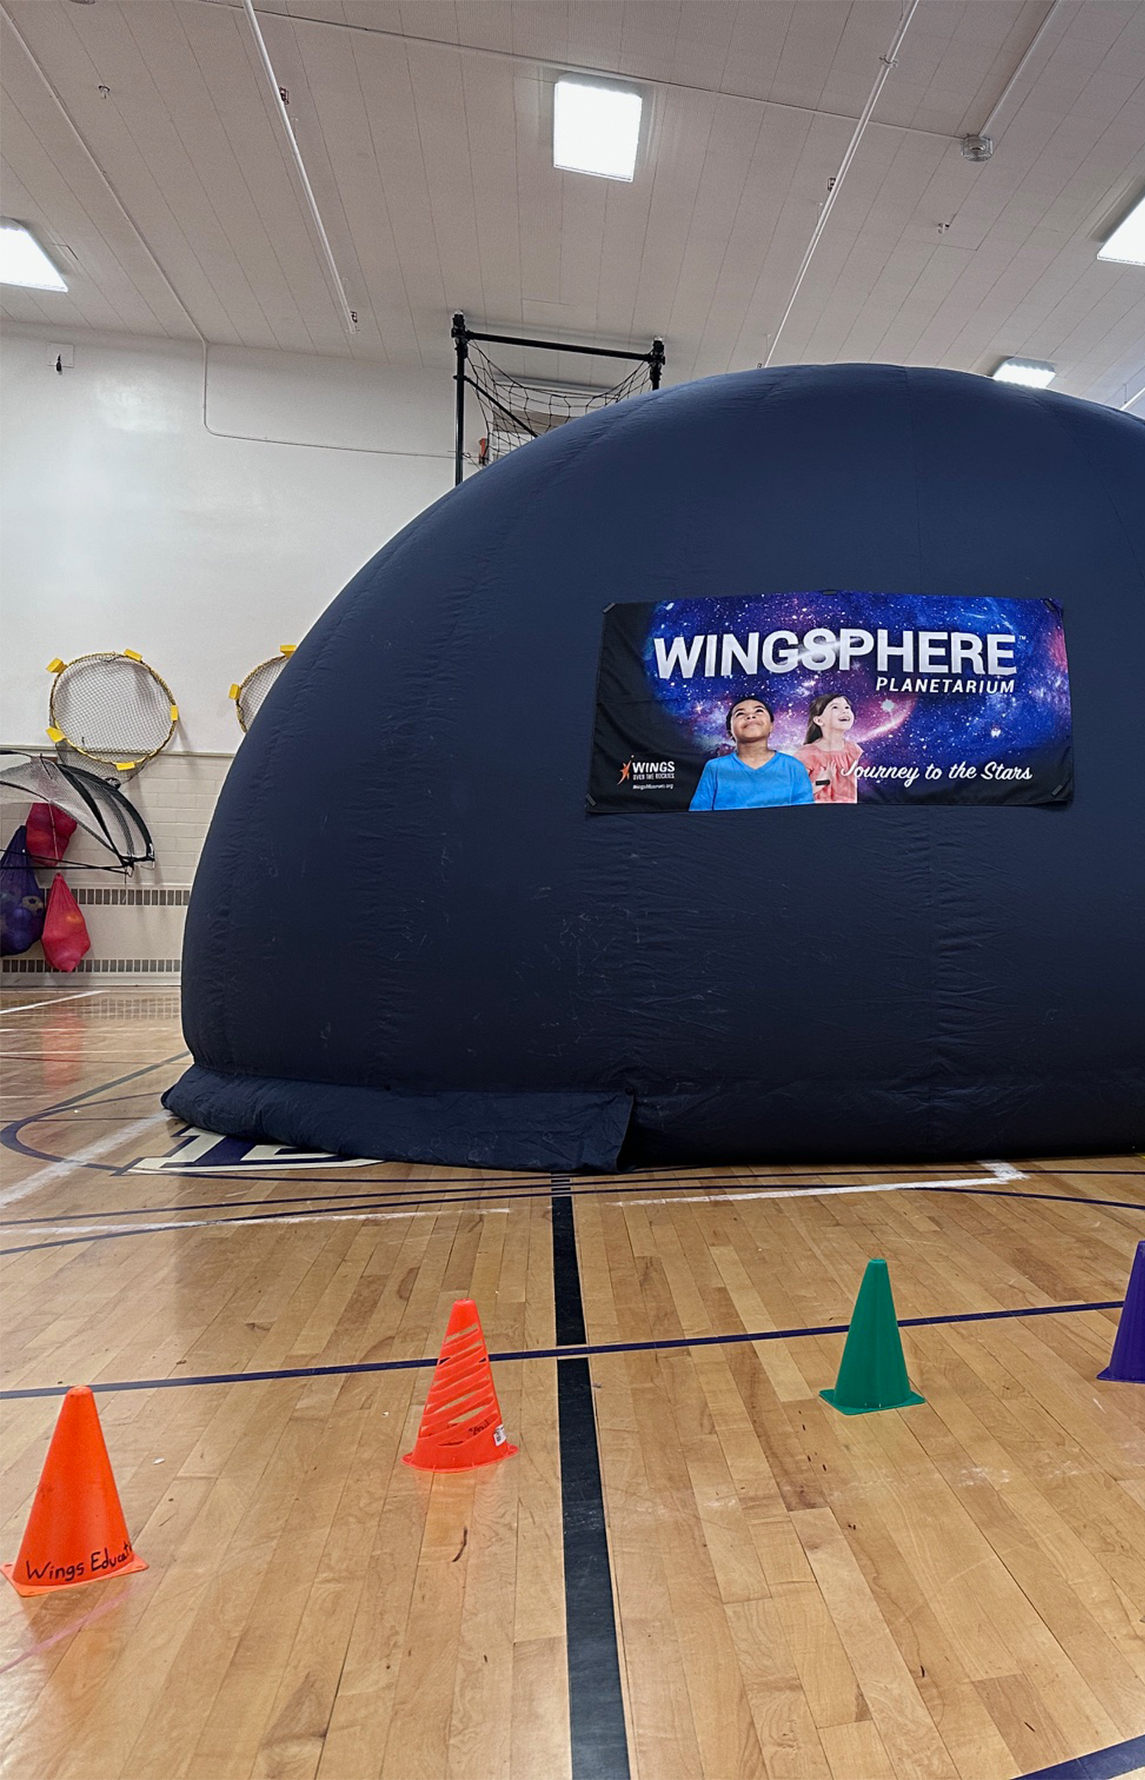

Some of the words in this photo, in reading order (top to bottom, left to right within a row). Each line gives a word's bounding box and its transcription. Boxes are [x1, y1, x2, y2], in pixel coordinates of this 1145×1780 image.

[653, 628, 1017, 679] WINGSPHERE
[876, 677, 1015, 694] PLANETARIUM
[632, 761, 676, 774] WINGS
[840, 760, 920, 788] Journey
[924, 763, 943, 780] to
[949, 761, 977, 779] the
[981, 761, 1033, 780] Stars
[25, 1560, 85, 1582] Wings
